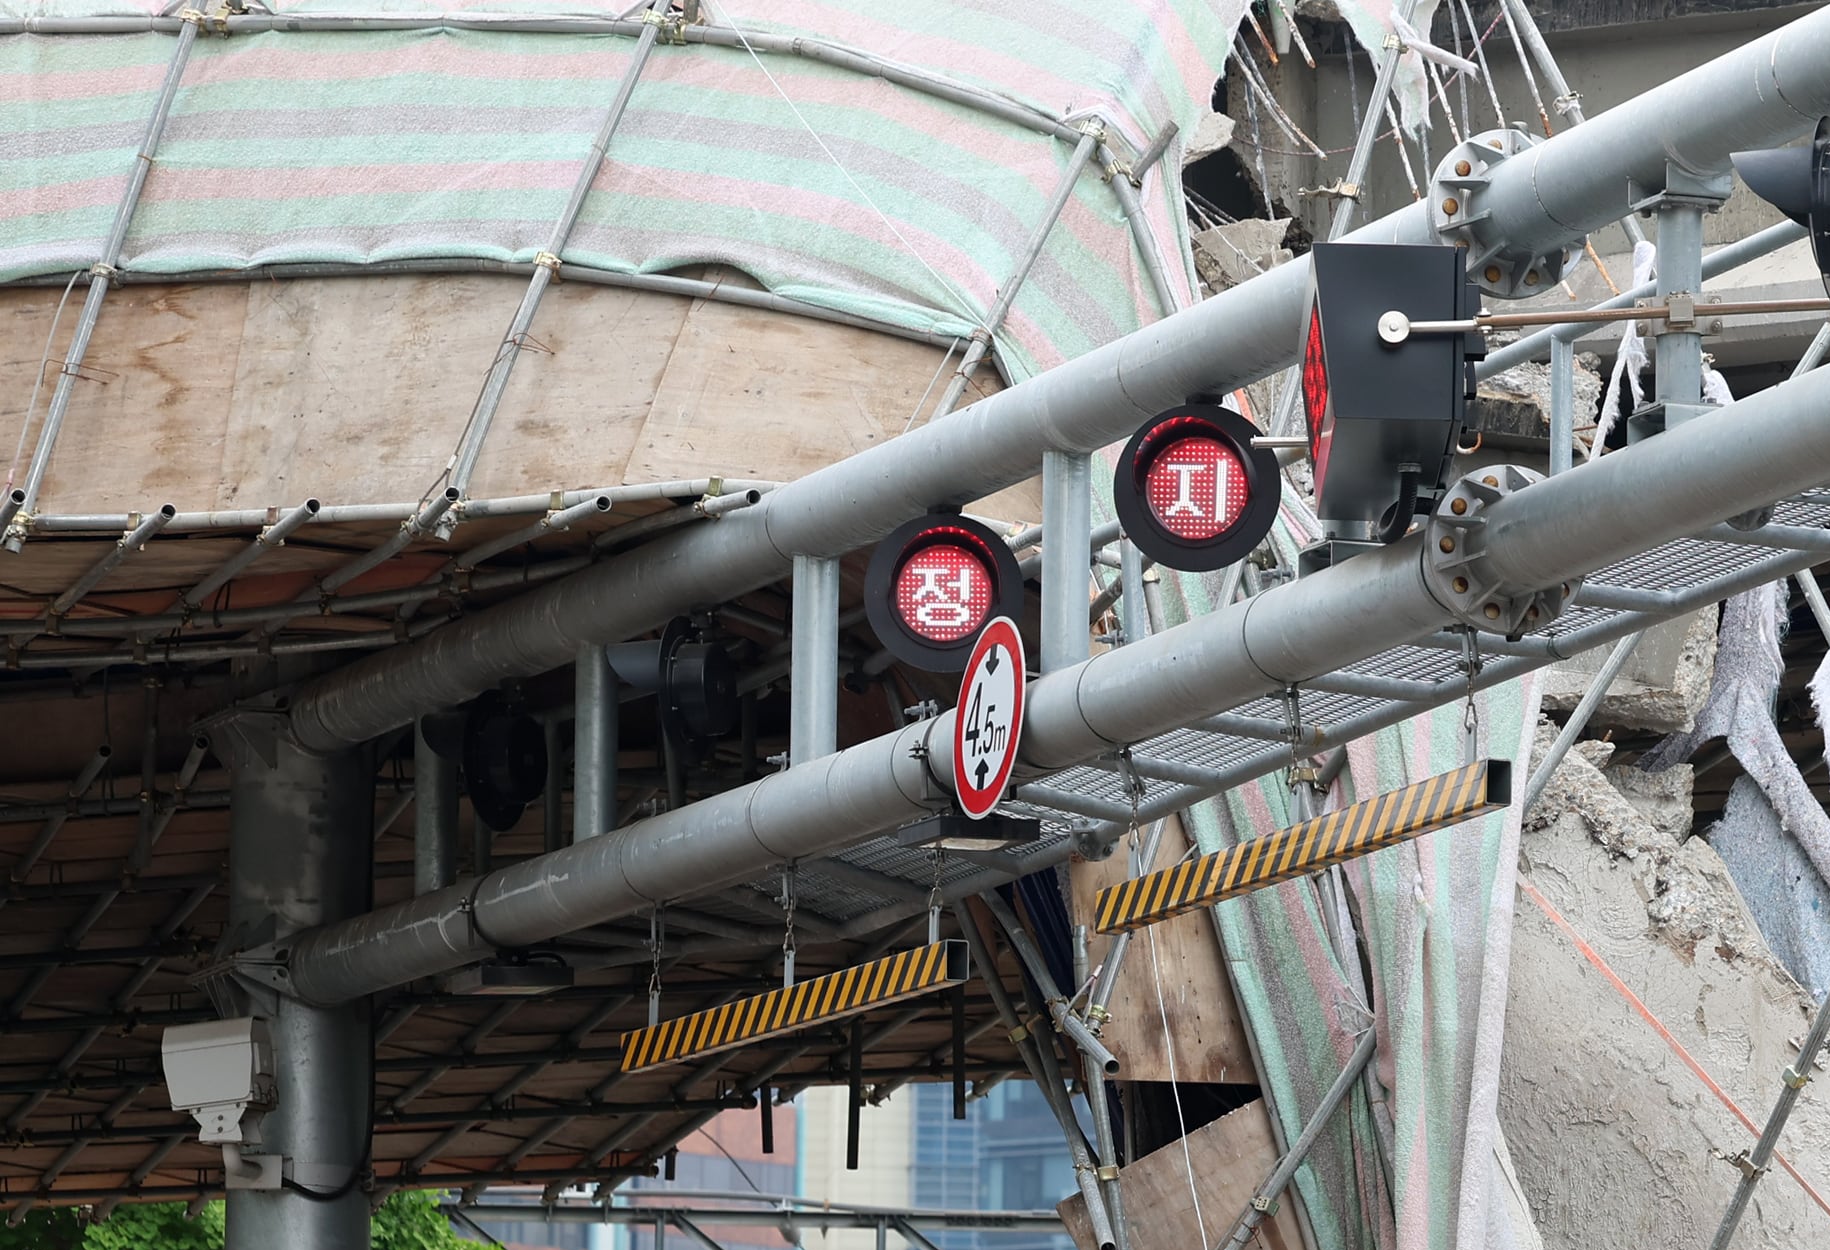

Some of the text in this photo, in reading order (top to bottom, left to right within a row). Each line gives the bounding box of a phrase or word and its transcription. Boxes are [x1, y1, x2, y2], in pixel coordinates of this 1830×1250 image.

[1165, 458, 1227, 522] 지
[911, 566, 971, 627] 정
[965, 682, 1006, 757] 4.5m
